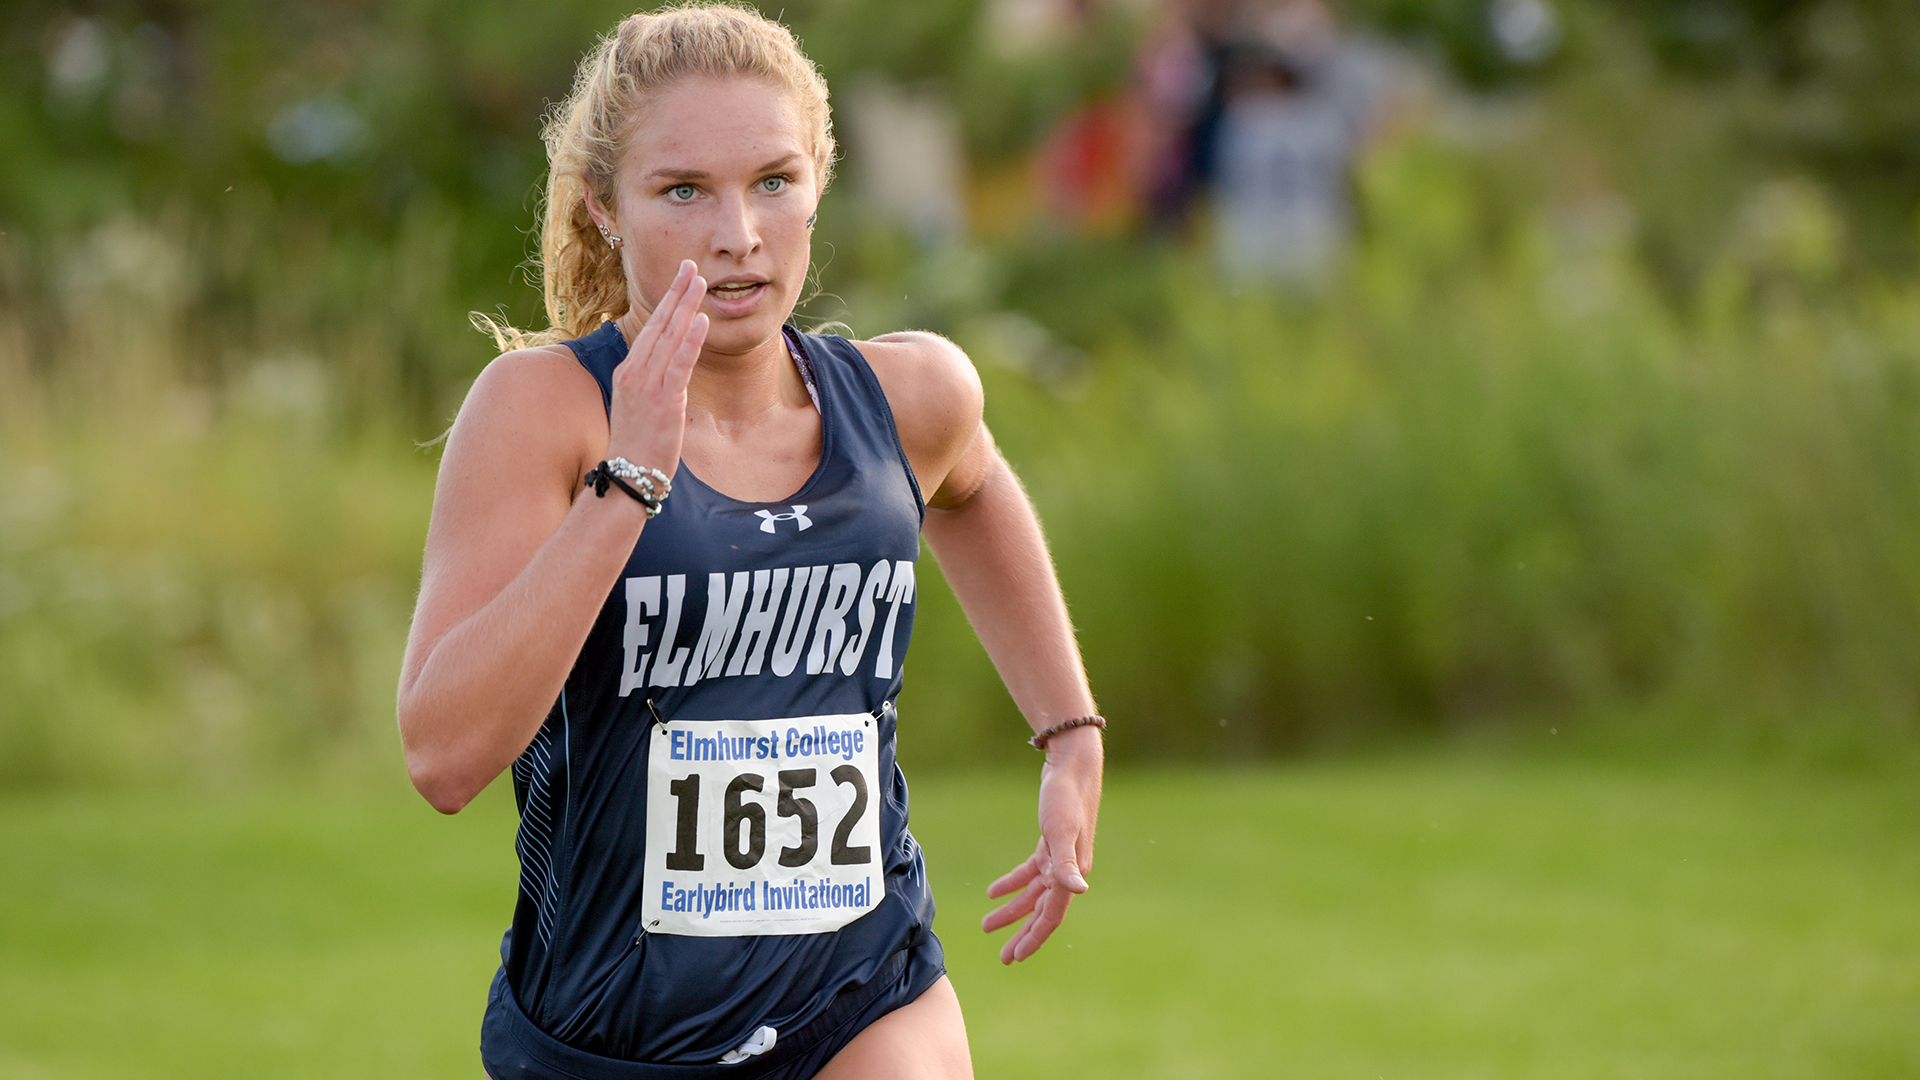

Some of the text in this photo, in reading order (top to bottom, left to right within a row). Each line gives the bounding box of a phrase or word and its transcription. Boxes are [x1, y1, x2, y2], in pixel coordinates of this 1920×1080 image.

[618, 559, 914, 697] ELMHURST
[670, 725, 864, 761] Elmhurst College
[666, 764, 871, 871] 1652
[661, 876, 871, 919] Earlybird Invitational
